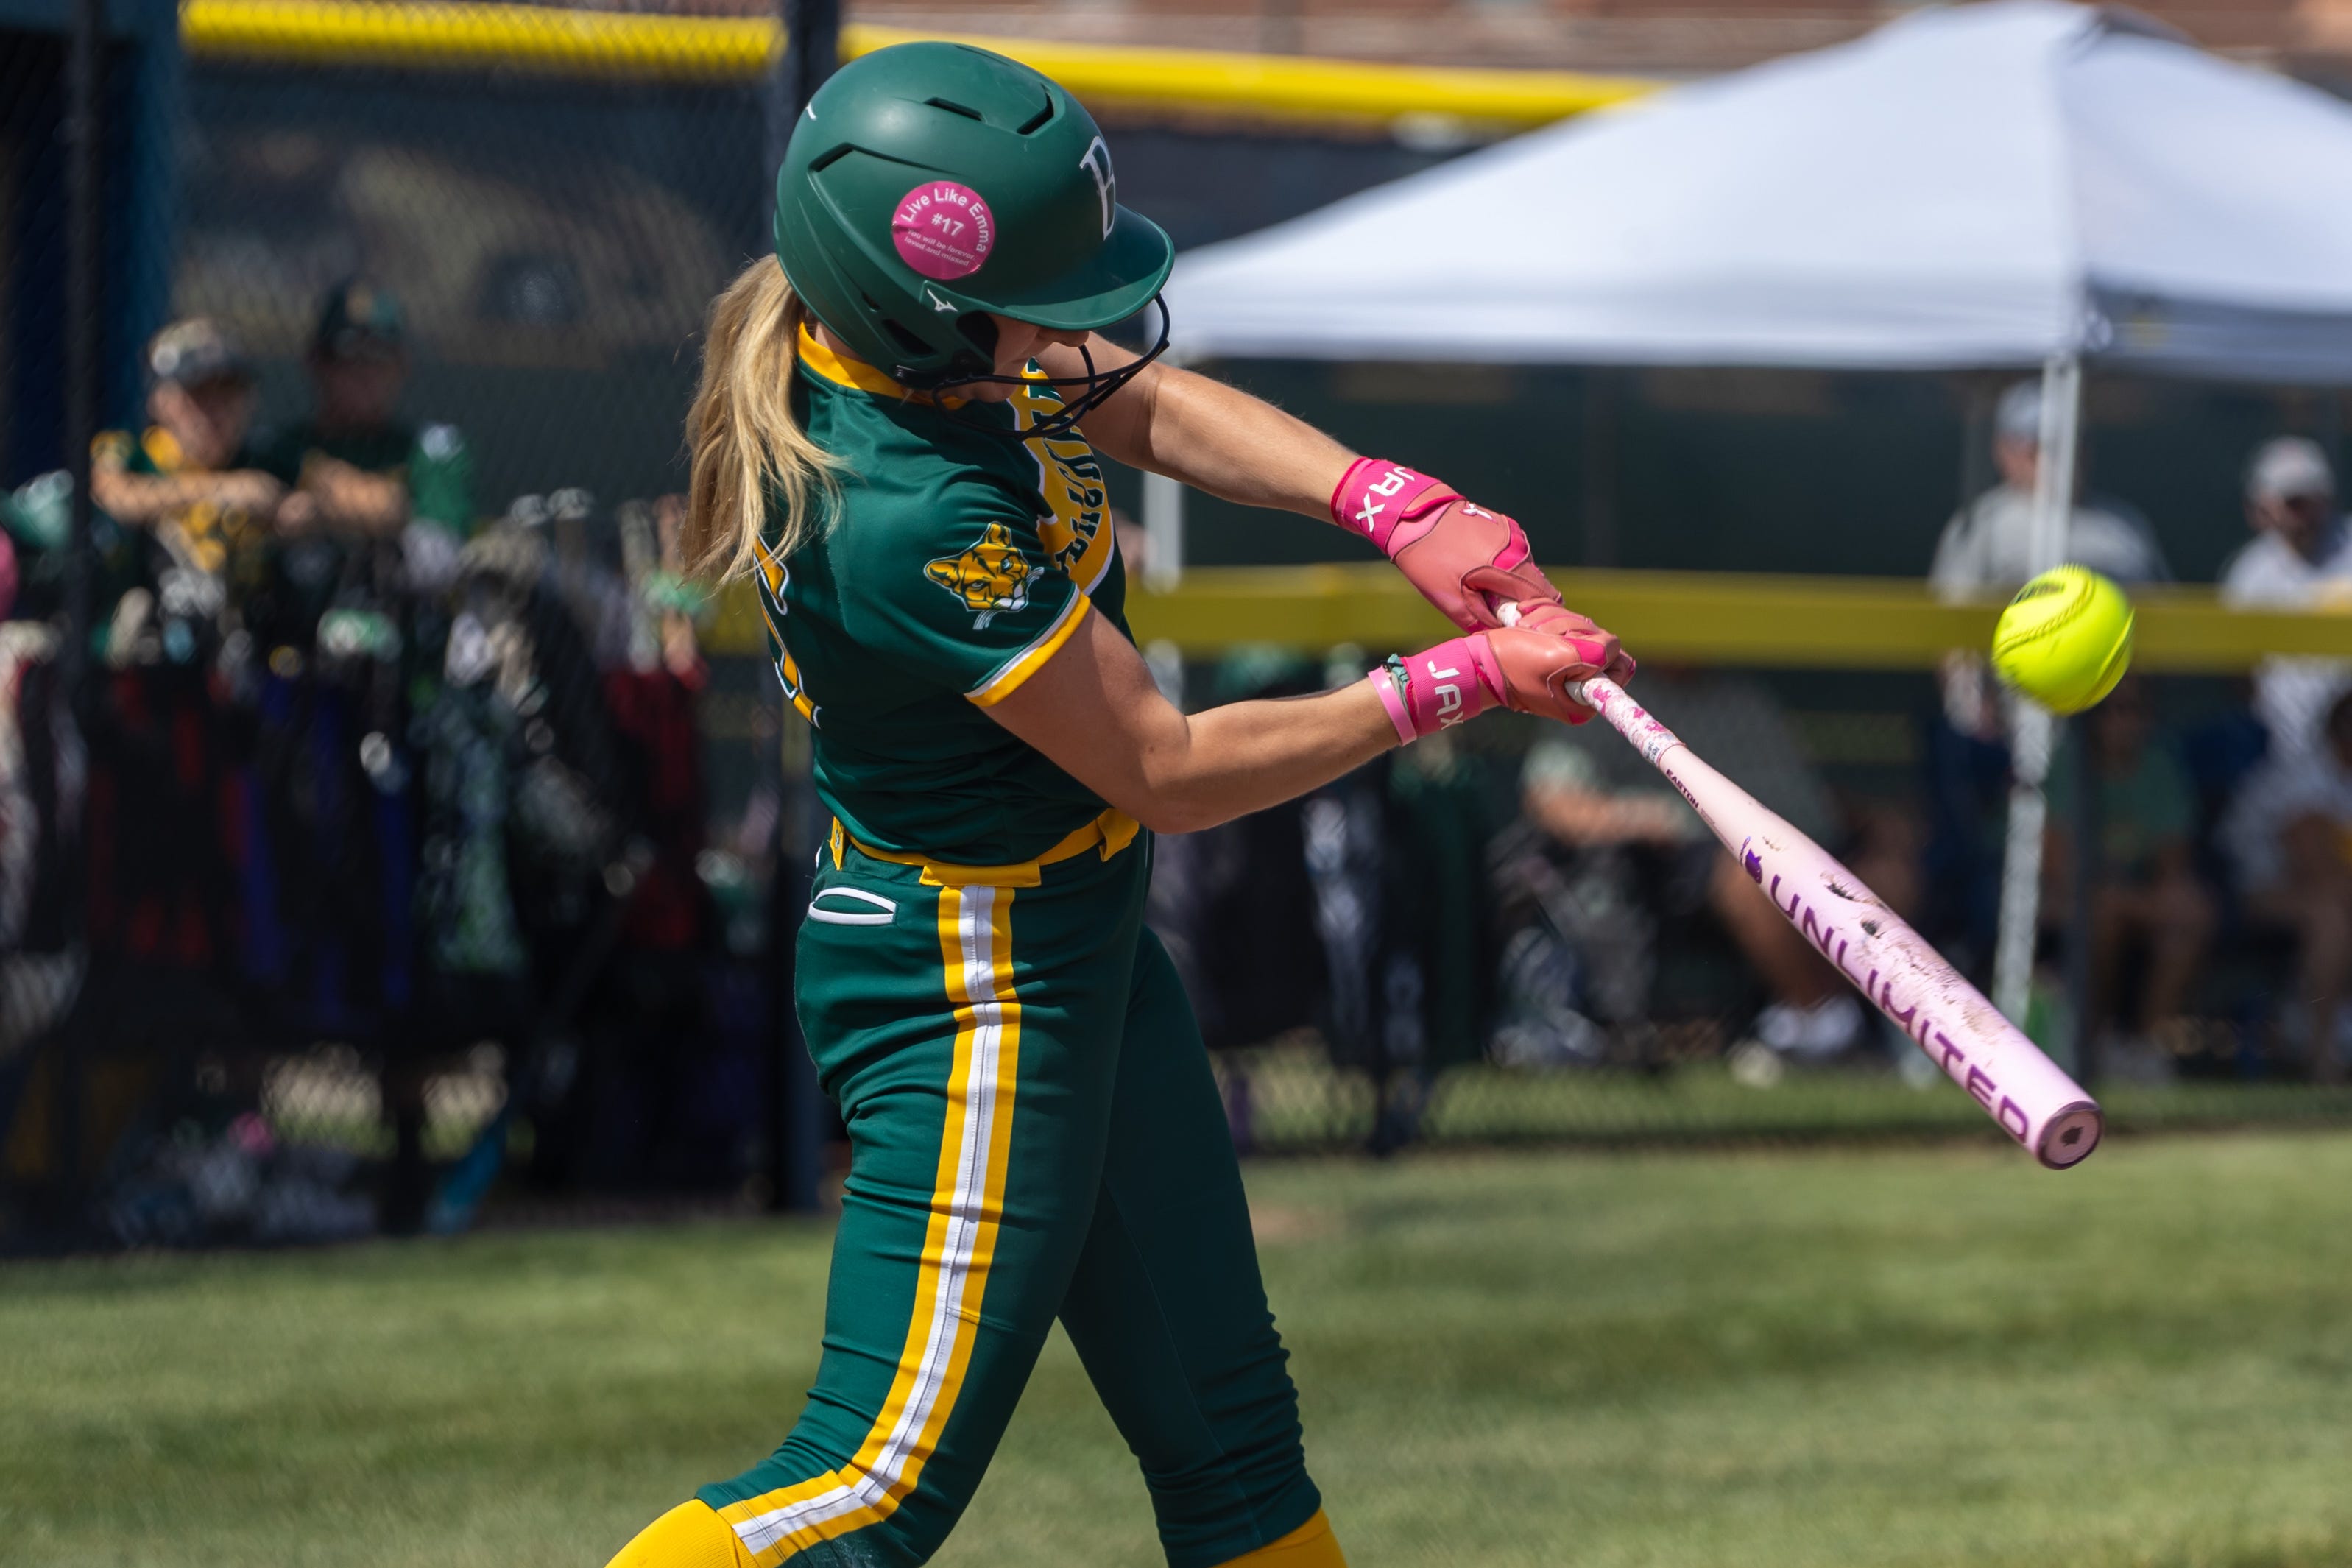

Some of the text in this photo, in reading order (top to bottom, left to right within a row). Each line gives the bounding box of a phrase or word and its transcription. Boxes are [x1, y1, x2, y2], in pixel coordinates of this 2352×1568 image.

[900, 188, 989, 252] Live Like Emma
[931, 212, 964, 236] #17
[904, 236, 970, 266] loved and missed
[922, 236, 936, 245] will
[936, 241, 946, 250] be
[947, 245, 974, 260] forever
[1356, 465, 1415, 532] JAX
[1427, 660, 1463, 730] JAX
[1666, 769, 1699, 809] EASTON
[1770, 874, 2029, 1144] UNLIMITED
